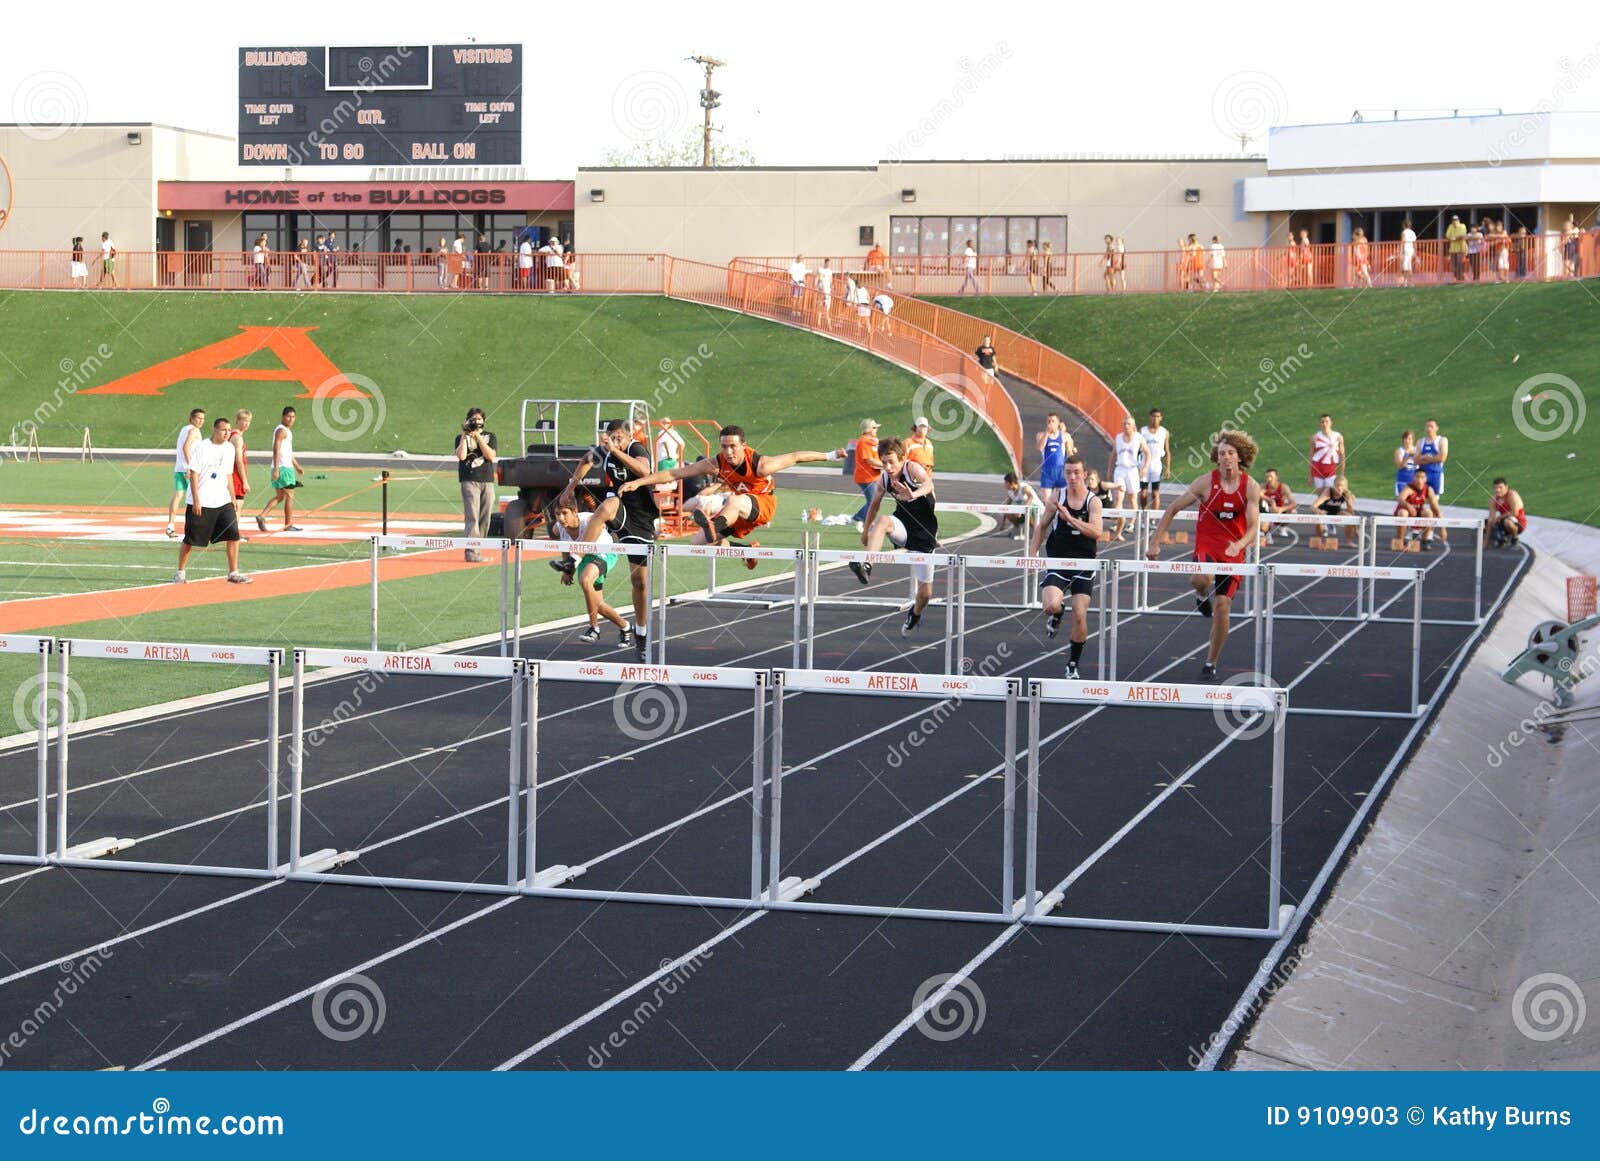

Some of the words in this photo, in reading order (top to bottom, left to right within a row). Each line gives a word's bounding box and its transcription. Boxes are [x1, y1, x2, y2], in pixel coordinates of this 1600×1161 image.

[245, 51, 307, 66] BULLDOGS
[453, 48, 512, 64] VISITORS
[244, 104, 267, 114] TIME
[269, 104, 294, 113] OUTS
[464, 102, 487, 112] TIME
[490, 102, 515, 112] OUTS
[259, 115, 280, 125] LEFT
[479, 114, 500, 123] LEFT
[243, 144, 288, 160] DOWN
[319, 143, 338, 160] TO
[343, 143, 364, 160] GO
[412, 143, 449, 160] BALL
[453, 143, 476, 159] ON
[225, 190, 300, 204] HOME
[307, 192, 325, 202] of
[333, 191, 362, 202] the
[369, 189, 506, 204] BULLDOGS
[74, 325, 374, 399] A
[425, 539, 453, 548] ARTESIA
[569, 543, 598, 553] ARTESIA
[716, 548, 745, 557] ARTESIA
[865, 553, 896, 563] ARTESIA
[1016, 559, 1047, 569] ARTESIA
[1170, 563, 1202, 572] ARTESIA
[1328, 568, 1360, 577] ARTESIA
[144, 645, 190, 661] ARTESIA
[384, 655, 432, 670] ARTESIA
[620, 666, 670, 682] ARTESIA
[867, 675, 919, 691] ARTESIA
[1127, 687, 1181, 702] ARTESIA
